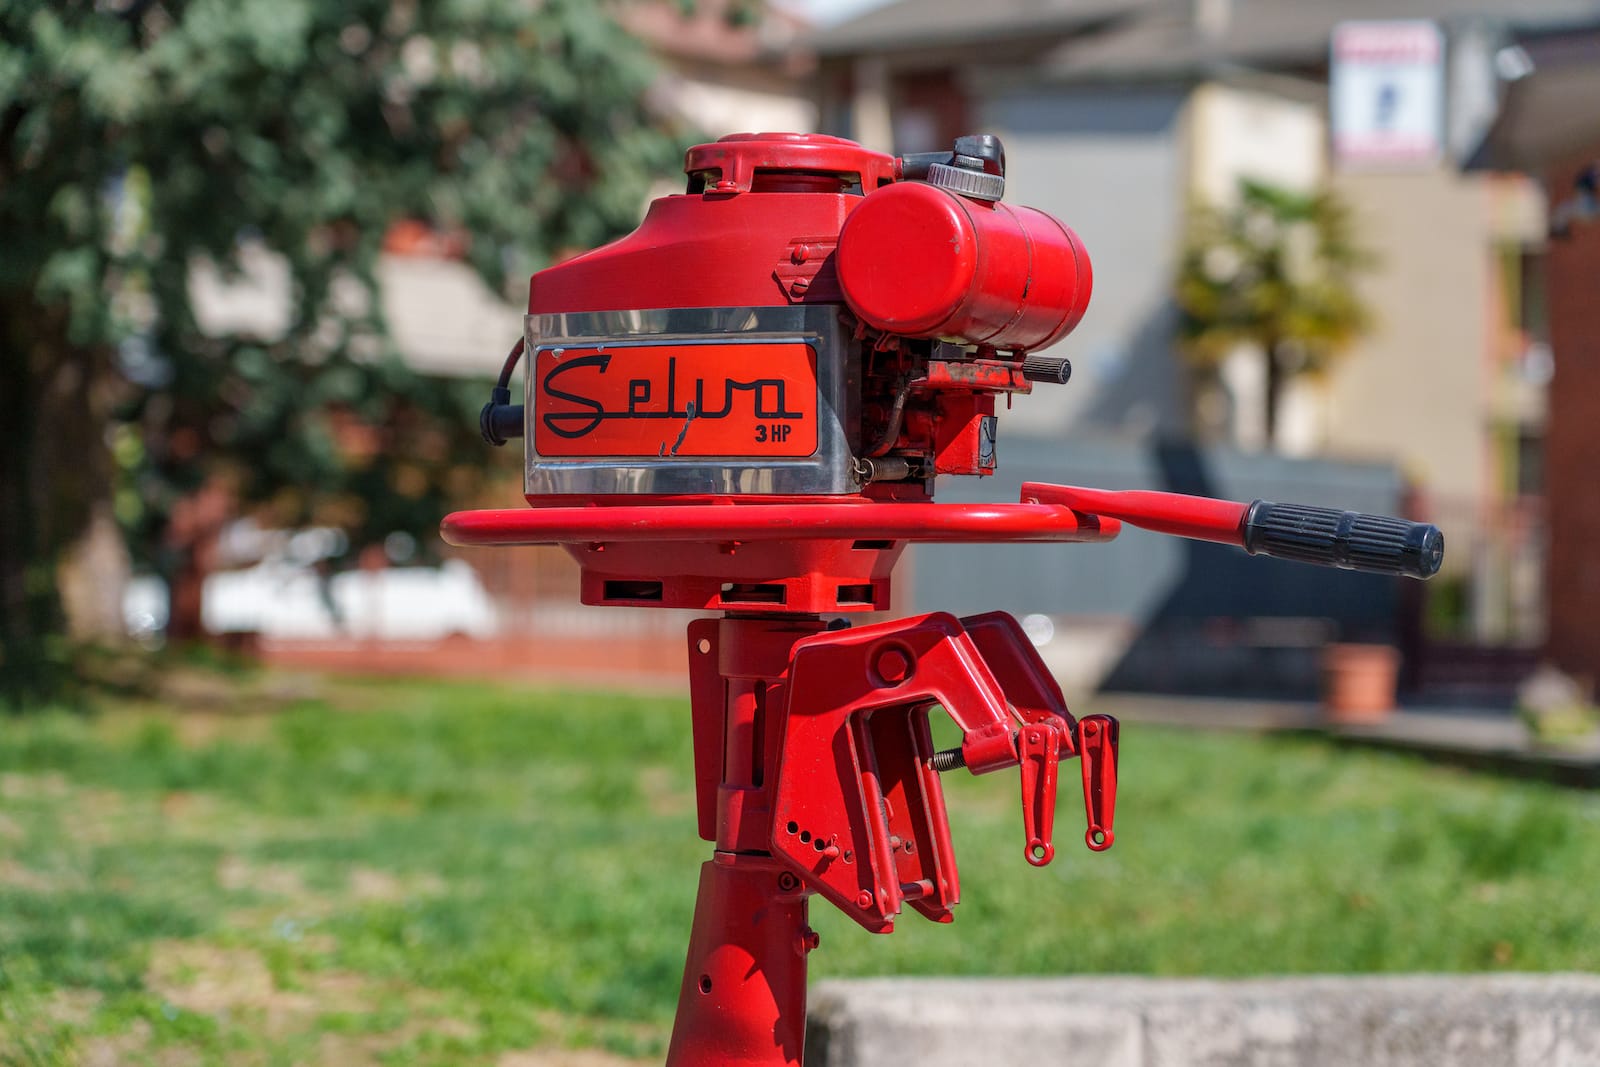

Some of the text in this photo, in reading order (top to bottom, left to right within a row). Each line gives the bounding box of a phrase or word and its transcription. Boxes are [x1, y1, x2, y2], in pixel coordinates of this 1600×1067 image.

[543, 354, 803, 439] Selva
[755, 424, 792, 442] 3 HP
